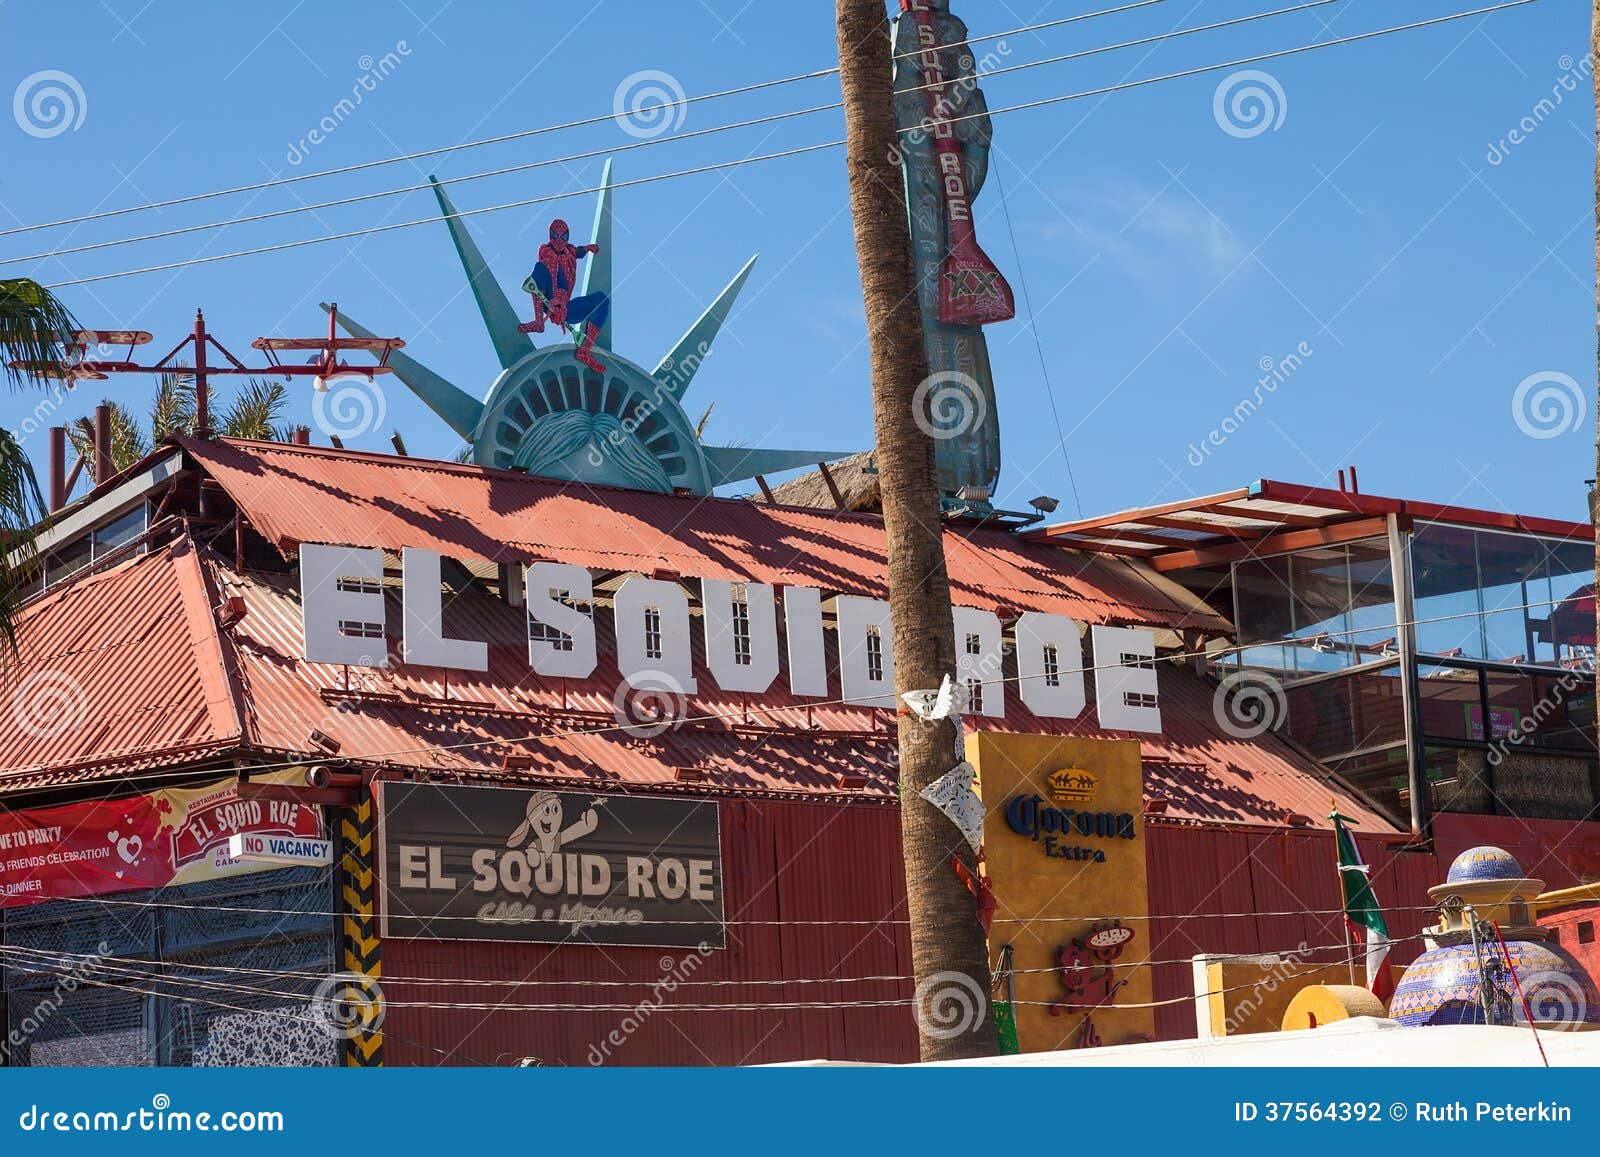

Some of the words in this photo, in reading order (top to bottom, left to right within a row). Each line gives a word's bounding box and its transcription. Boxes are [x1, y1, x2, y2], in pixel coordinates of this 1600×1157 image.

[940, 152, 969, 221] ROE
[299, 543, 488, 672] EL
[525, 562, 897, 711] SQUID
[950, 605, 1162, 734] ROE
[188, 791, 225, 811] RESTAURANT
[189, 816, 214, 847] EL
[215, 800, 261, 834] SQUID
[269, 800, 299, 828] ROE
[1006, 793, 1136, 841] Corona
[12, 830, 27, 848] TO
[27, 826, 61, 845] PARTY
[245, 838, 264, 853] NO
[269, 840, 329, 858] VACANCY
[1045, 835, 1107, 862] Extra
[7, 855, 45, 871] FRIENDS
[47, 846, 110, 865] CELEBRATION
[400, 845, 457, 890] EL
[472, 848, 611, 899] SQUID
[626, 856, 714, 900] ROE
[7, 879, 42, 894] DINNER
